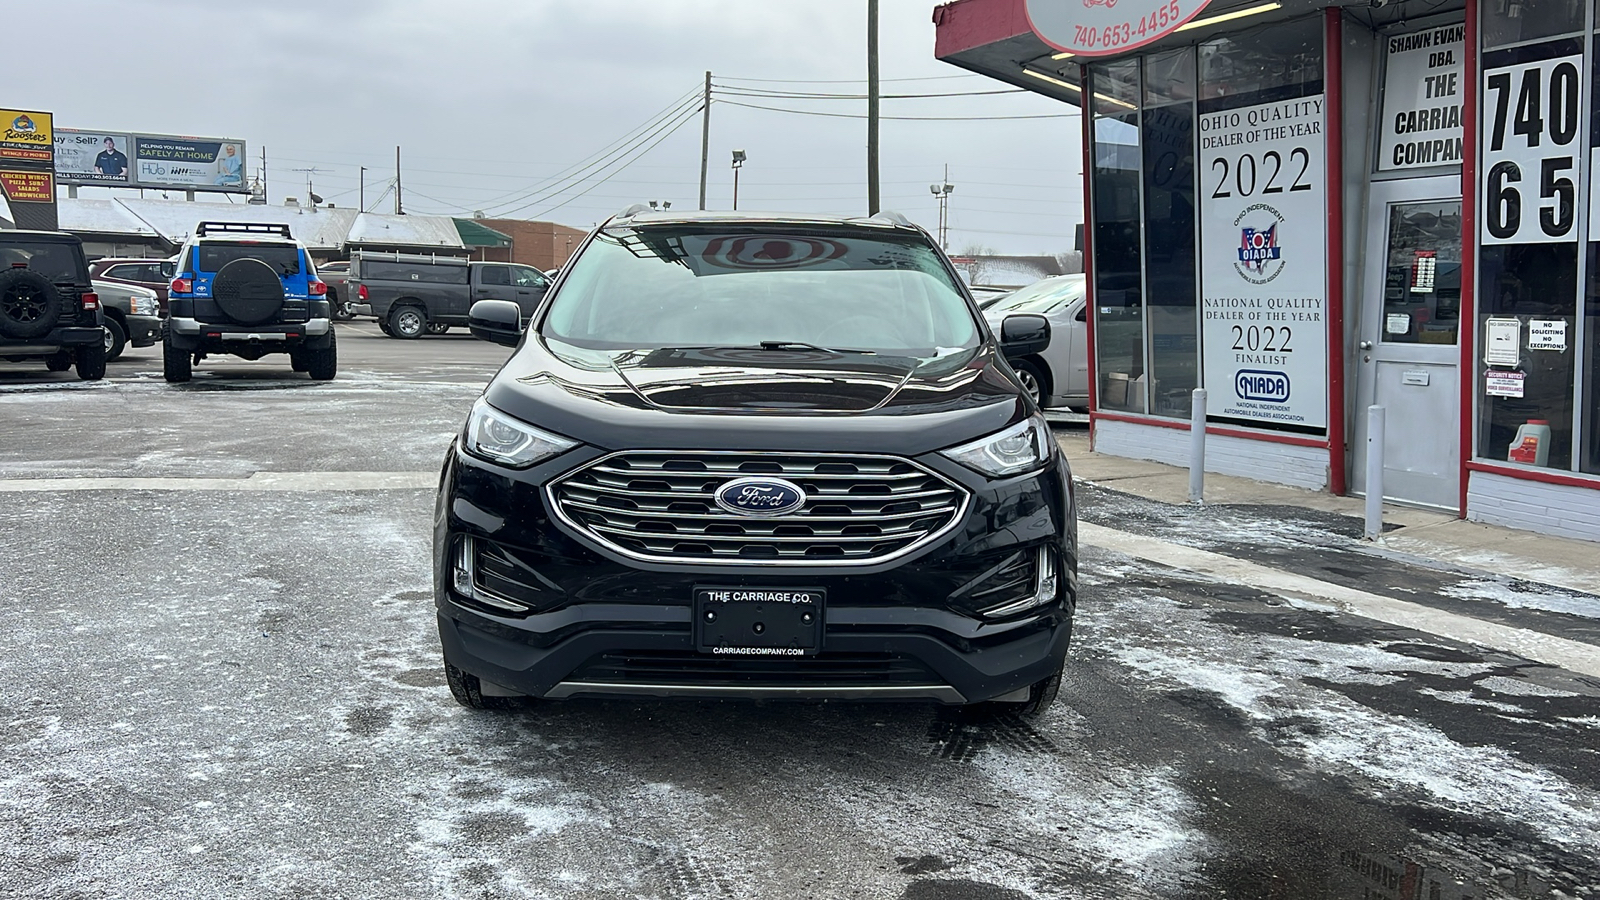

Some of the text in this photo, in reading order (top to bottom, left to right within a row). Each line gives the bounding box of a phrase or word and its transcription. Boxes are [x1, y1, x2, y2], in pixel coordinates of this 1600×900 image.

[1073, 1, 1180, 48] 740-653-4455
[1389, 26, 1465, 54] SHAWN EVAN
[1428, 50, 1455, 68] DBA.
[1424, 72, 1457, 99] THE
[1201, 99, 1323, 132] OHIO QUALITY
[1487, 61, 1579, 152] 740
[3, 128, 47, 142] Roosters
[75, 136, 98, 145] Sell?
[1203, 121, 1321, 149] DEALER OF THE YEAR
[139, 149, 214, 160] SAFELY AT HOME
[1211, 147, 1311, 199] 2022
[1233, 203, 1285, 227] OHIO INDEPENDENT
[1243, 248, 1274, 260] OIADA
[1233, 262, 1251, 283] AUTOMOBILE
[1266, 260, 1286, 282] ASSOCIATION
[1204, 298, 1322, 310] NATIONAL QUALITY
[1206, 310, 1321, 322] DEALER OF THE YEAR
[1231, 325, 1293, 353] 2022
[1235, 354, 1288, 366] FINALIST
[1239, 375, 1285, 397] NIADA
[1223, 408, 1251, 416] AUTOMOBILE
[1272, 413, 1305, 422] ASSOCIATION
[1258, 404, 1290, 412] INDEPENDENT
[737, 486, 784, 506] Ford
[707, 592, 812, 603] THE CARRIAGE CO.
[712, 647, 804, 656] CARRIAGECOMPANY.COM
